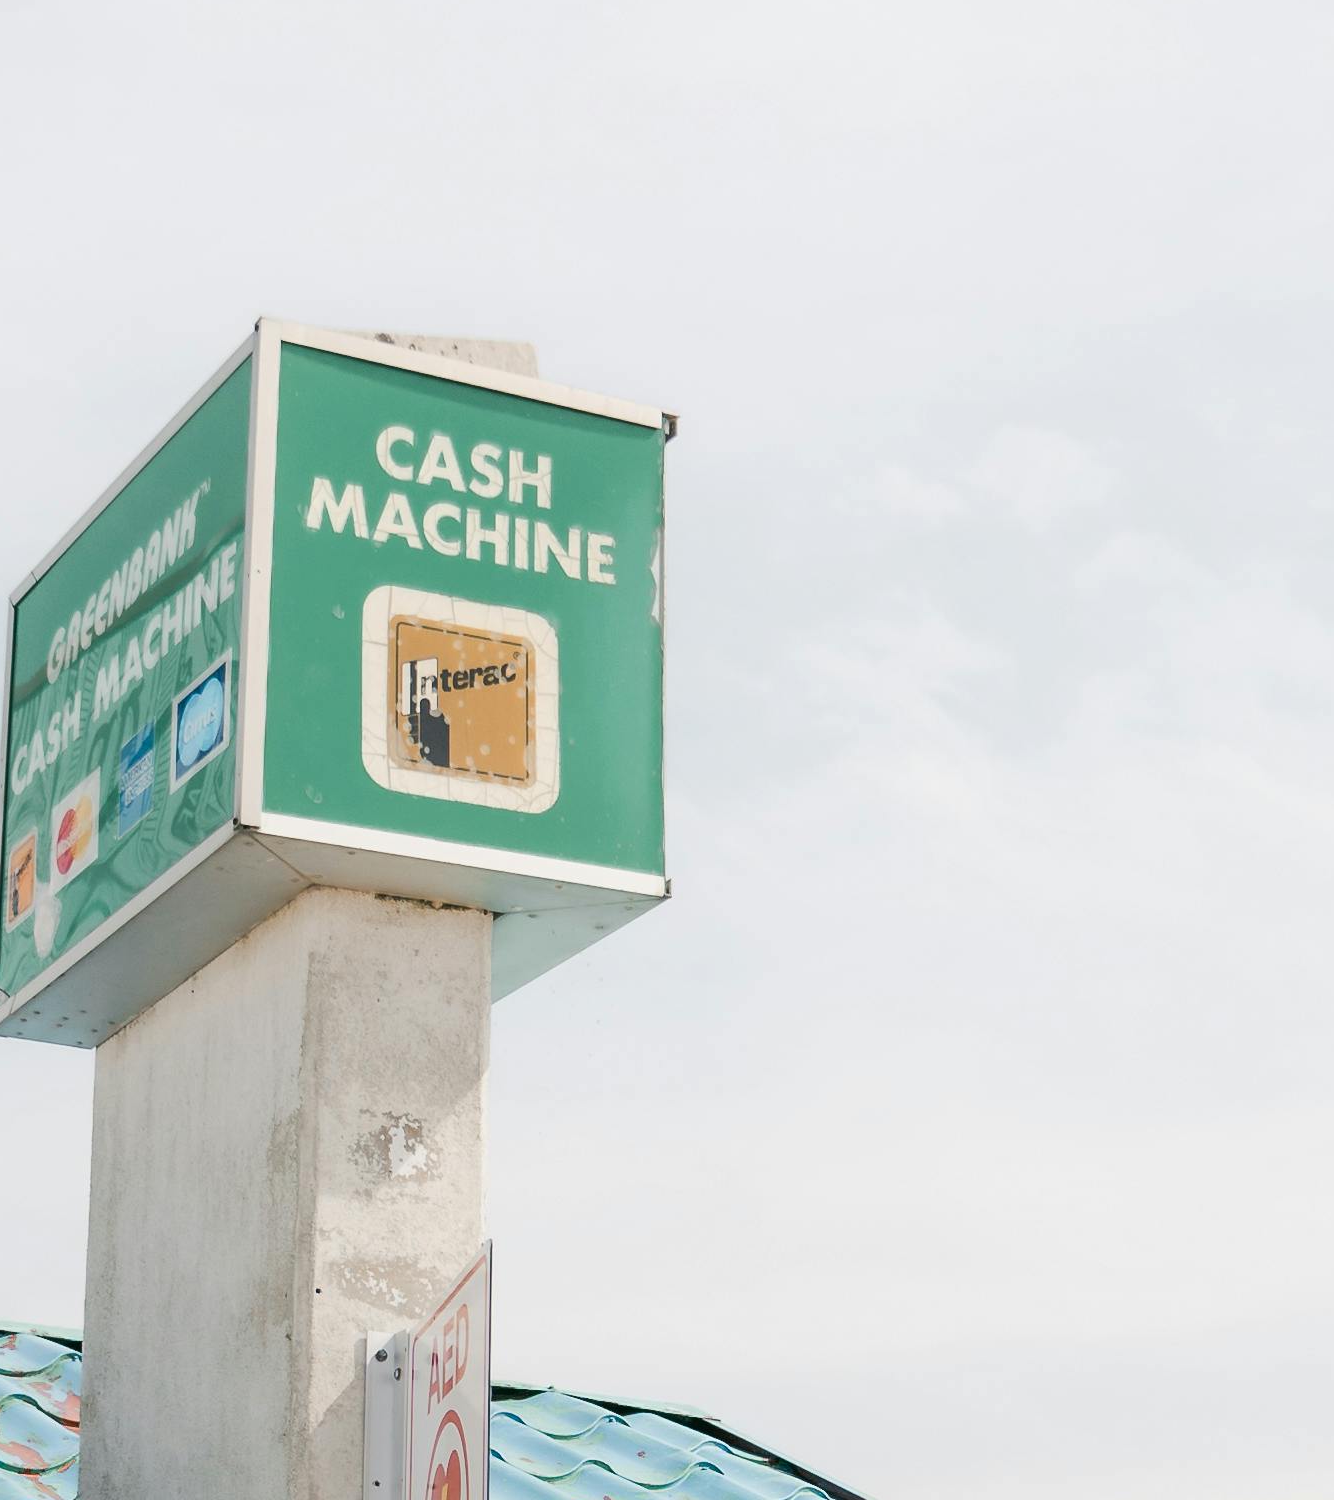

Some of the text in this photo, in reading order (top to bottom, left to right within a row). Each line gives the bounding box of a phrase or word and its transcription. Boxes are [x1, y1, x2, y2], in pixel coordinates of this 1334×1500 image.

[376, 425, 552, 509] CASH
[46, 488, 201, 684] GREENBANK
[307, 477, 616, 585] MACHINE
[11, 542, 237, 795] CASH MACHINE
[409, 660, 517, 710] Interac
[427, 1303, 469, 1416] AED
